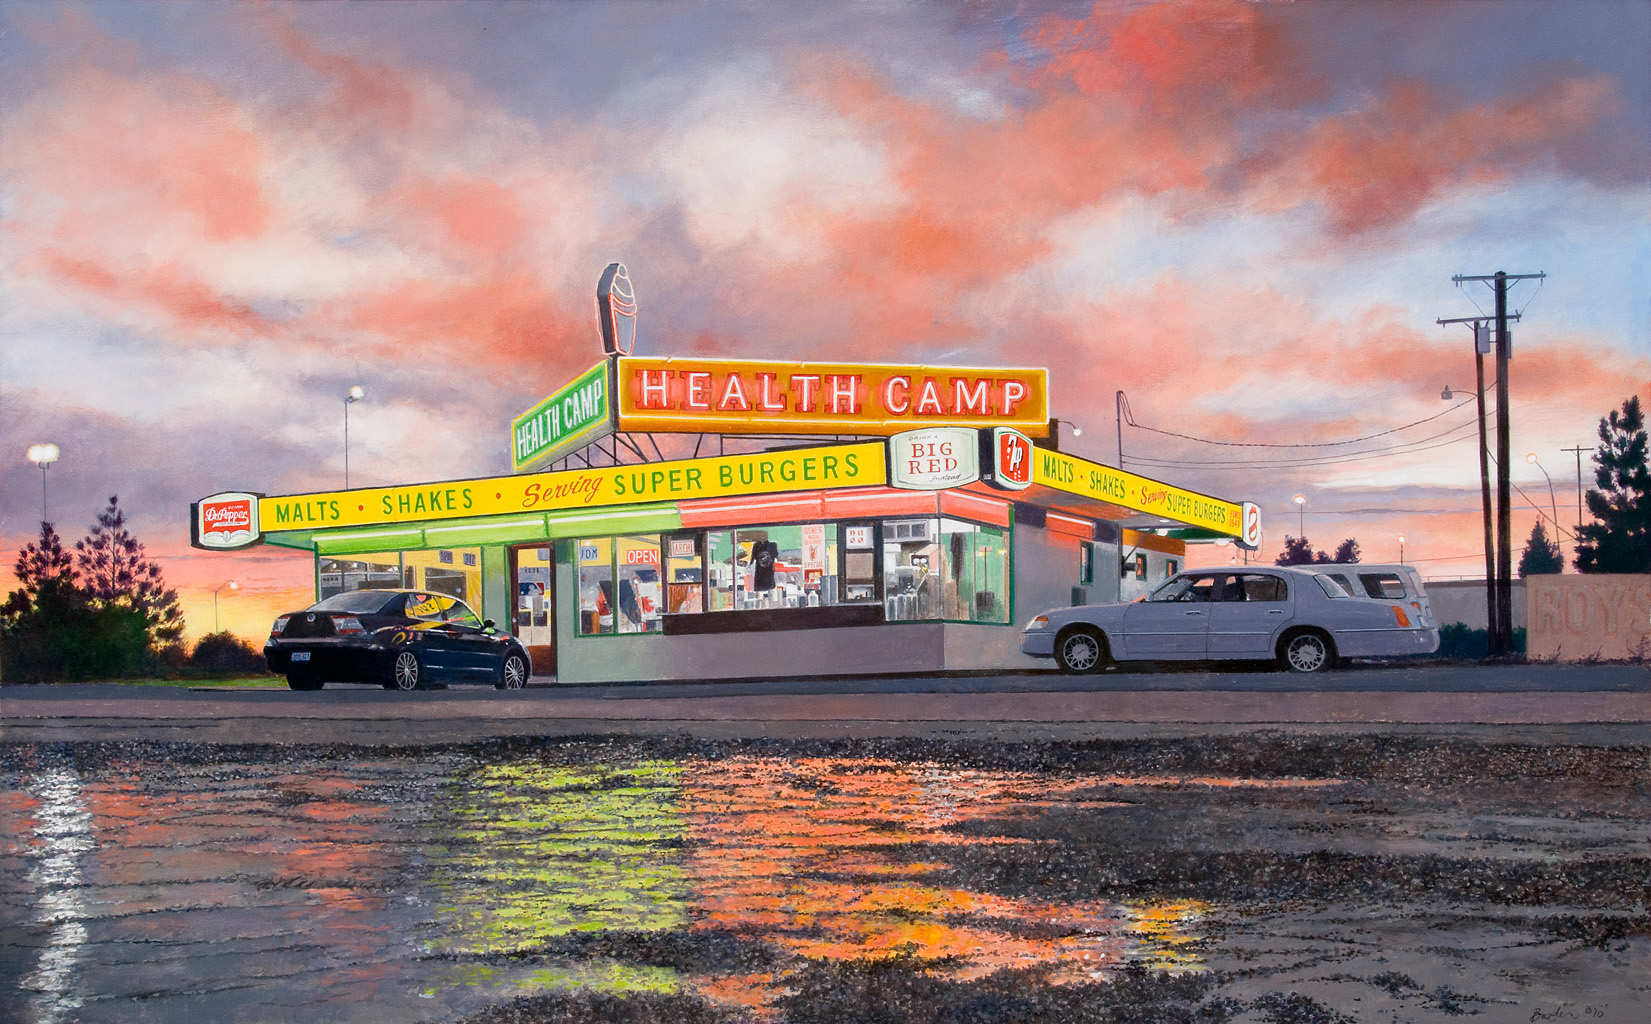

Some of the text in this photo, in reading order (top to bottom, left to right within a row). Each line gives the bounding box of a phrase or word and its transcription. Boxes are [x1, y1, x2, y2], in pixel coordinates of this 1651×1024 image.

[636, 370, 1030, 416] HEALTH CAMP
[517, 379, 602, 459] HEALTH CAMP
[911, 442, 952, 458] BIG
[908, 458, 957, 474] RED
[276, 453, 859, 523] MALTS SHAKES Serving SUPER BURGERS
[1043, 454, 1226, 524] MALTS SHAKES Serving SUPER BURGERS
[217, 507, 249, 523] Pepper
[627, 550, 658, 563] OPEN
